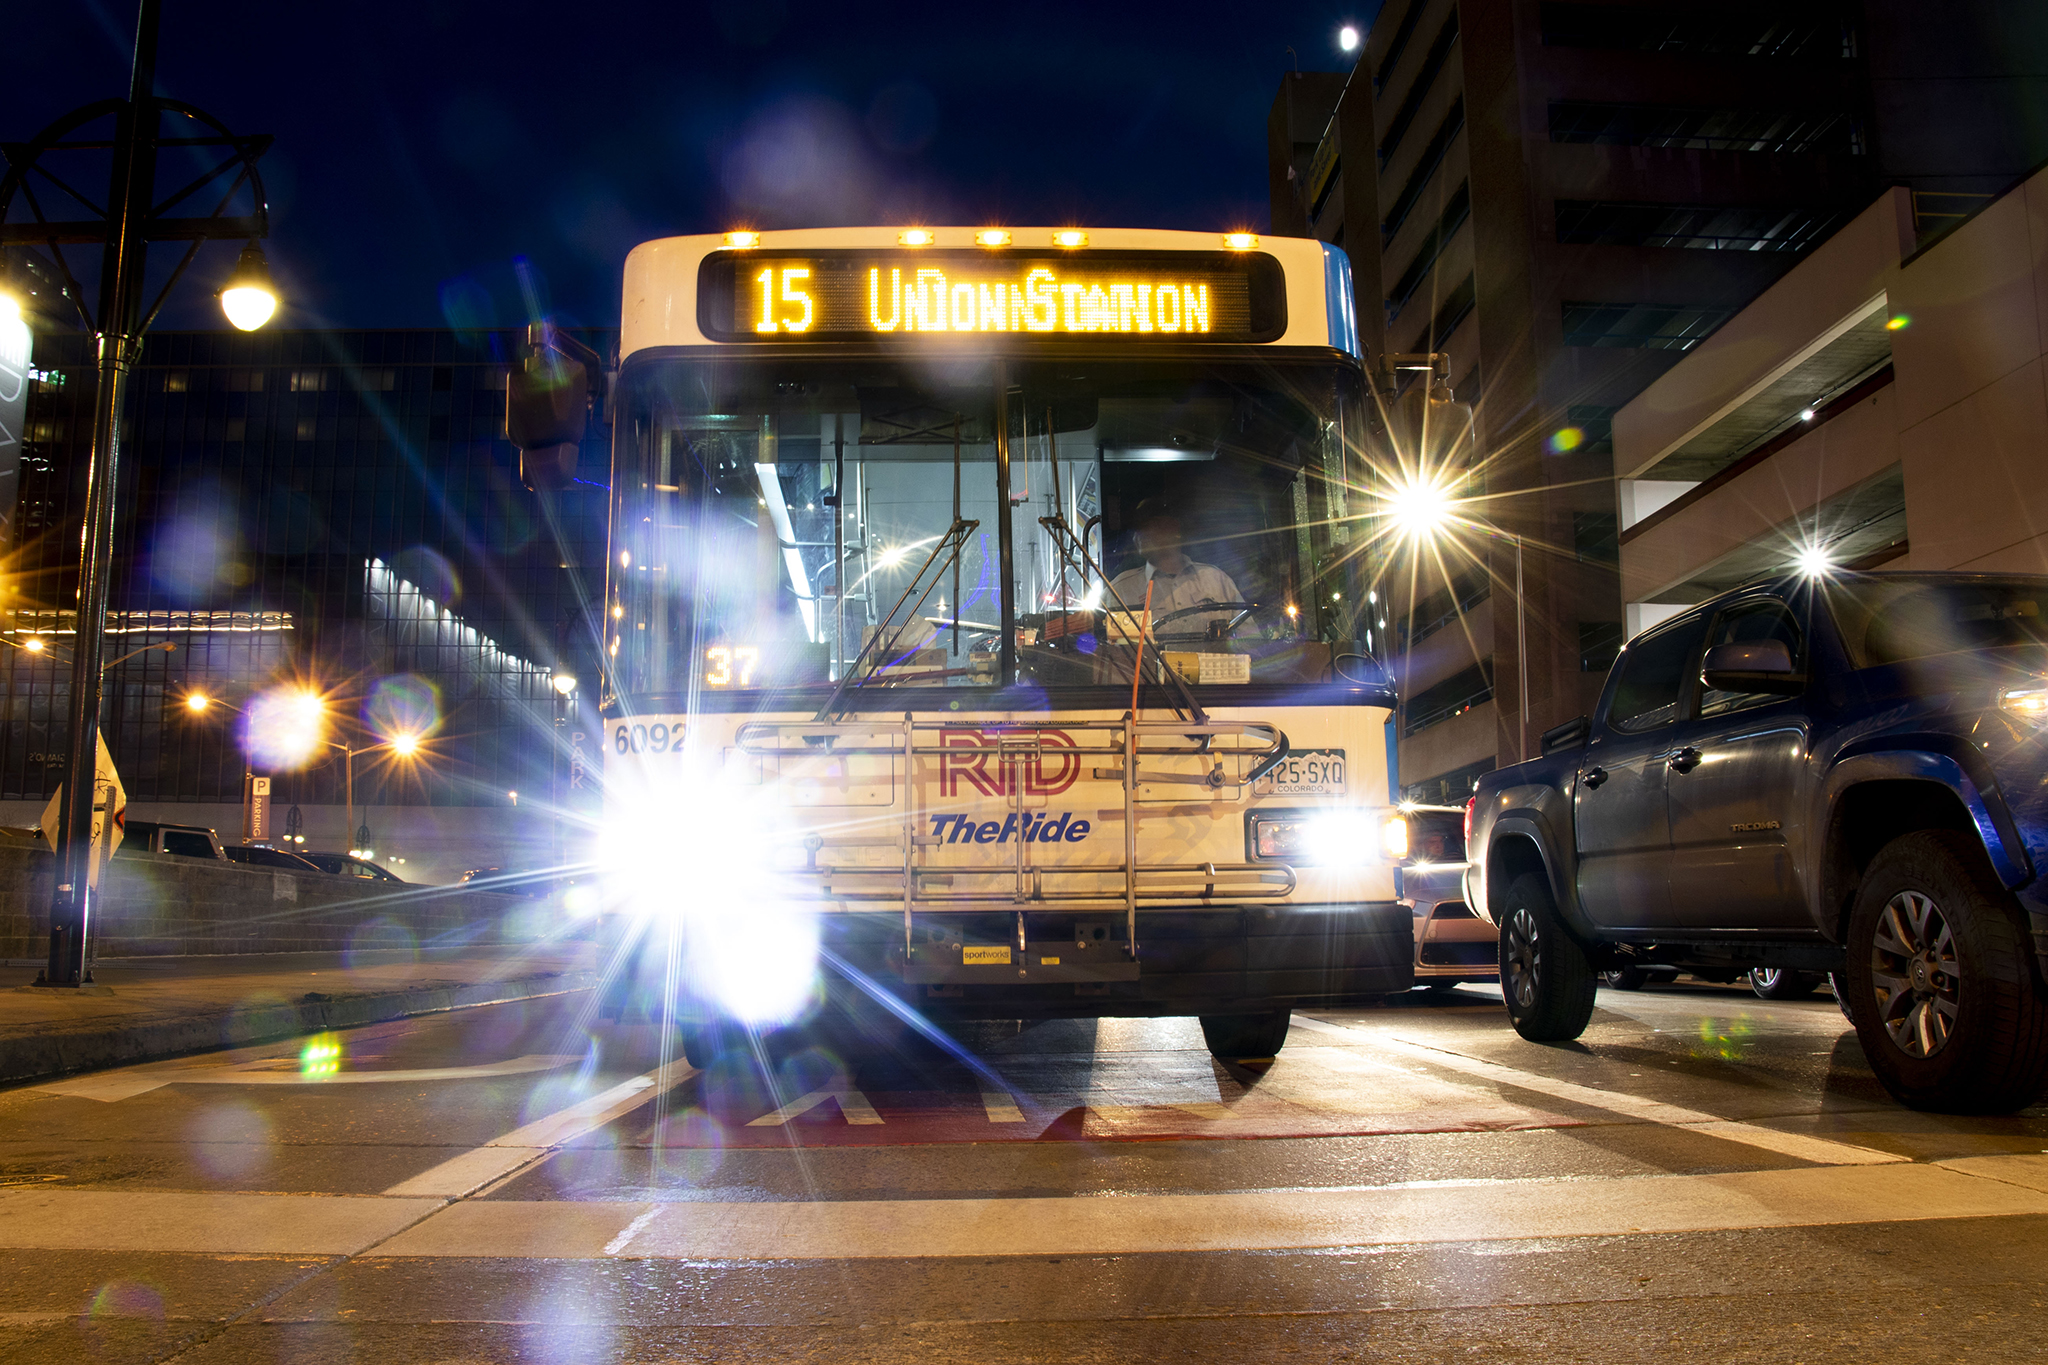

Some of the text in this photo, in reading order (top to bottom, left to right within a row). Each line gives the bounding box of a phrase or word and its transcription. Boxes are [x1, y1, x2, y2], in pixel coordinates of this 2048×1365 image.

[754, 268, 813, 333] 15
[706, 646, 759, 686] 37
[939, 728, 1081, 797] RTD
[257, 780, 267, 793] P
[1277, 784, 1324, 793] COLORADO
[252, 797, 262, 837] PARKING
[1730, 820, 1781, 832] TACOMA
[964, 950, 1010, 960] sportworks
